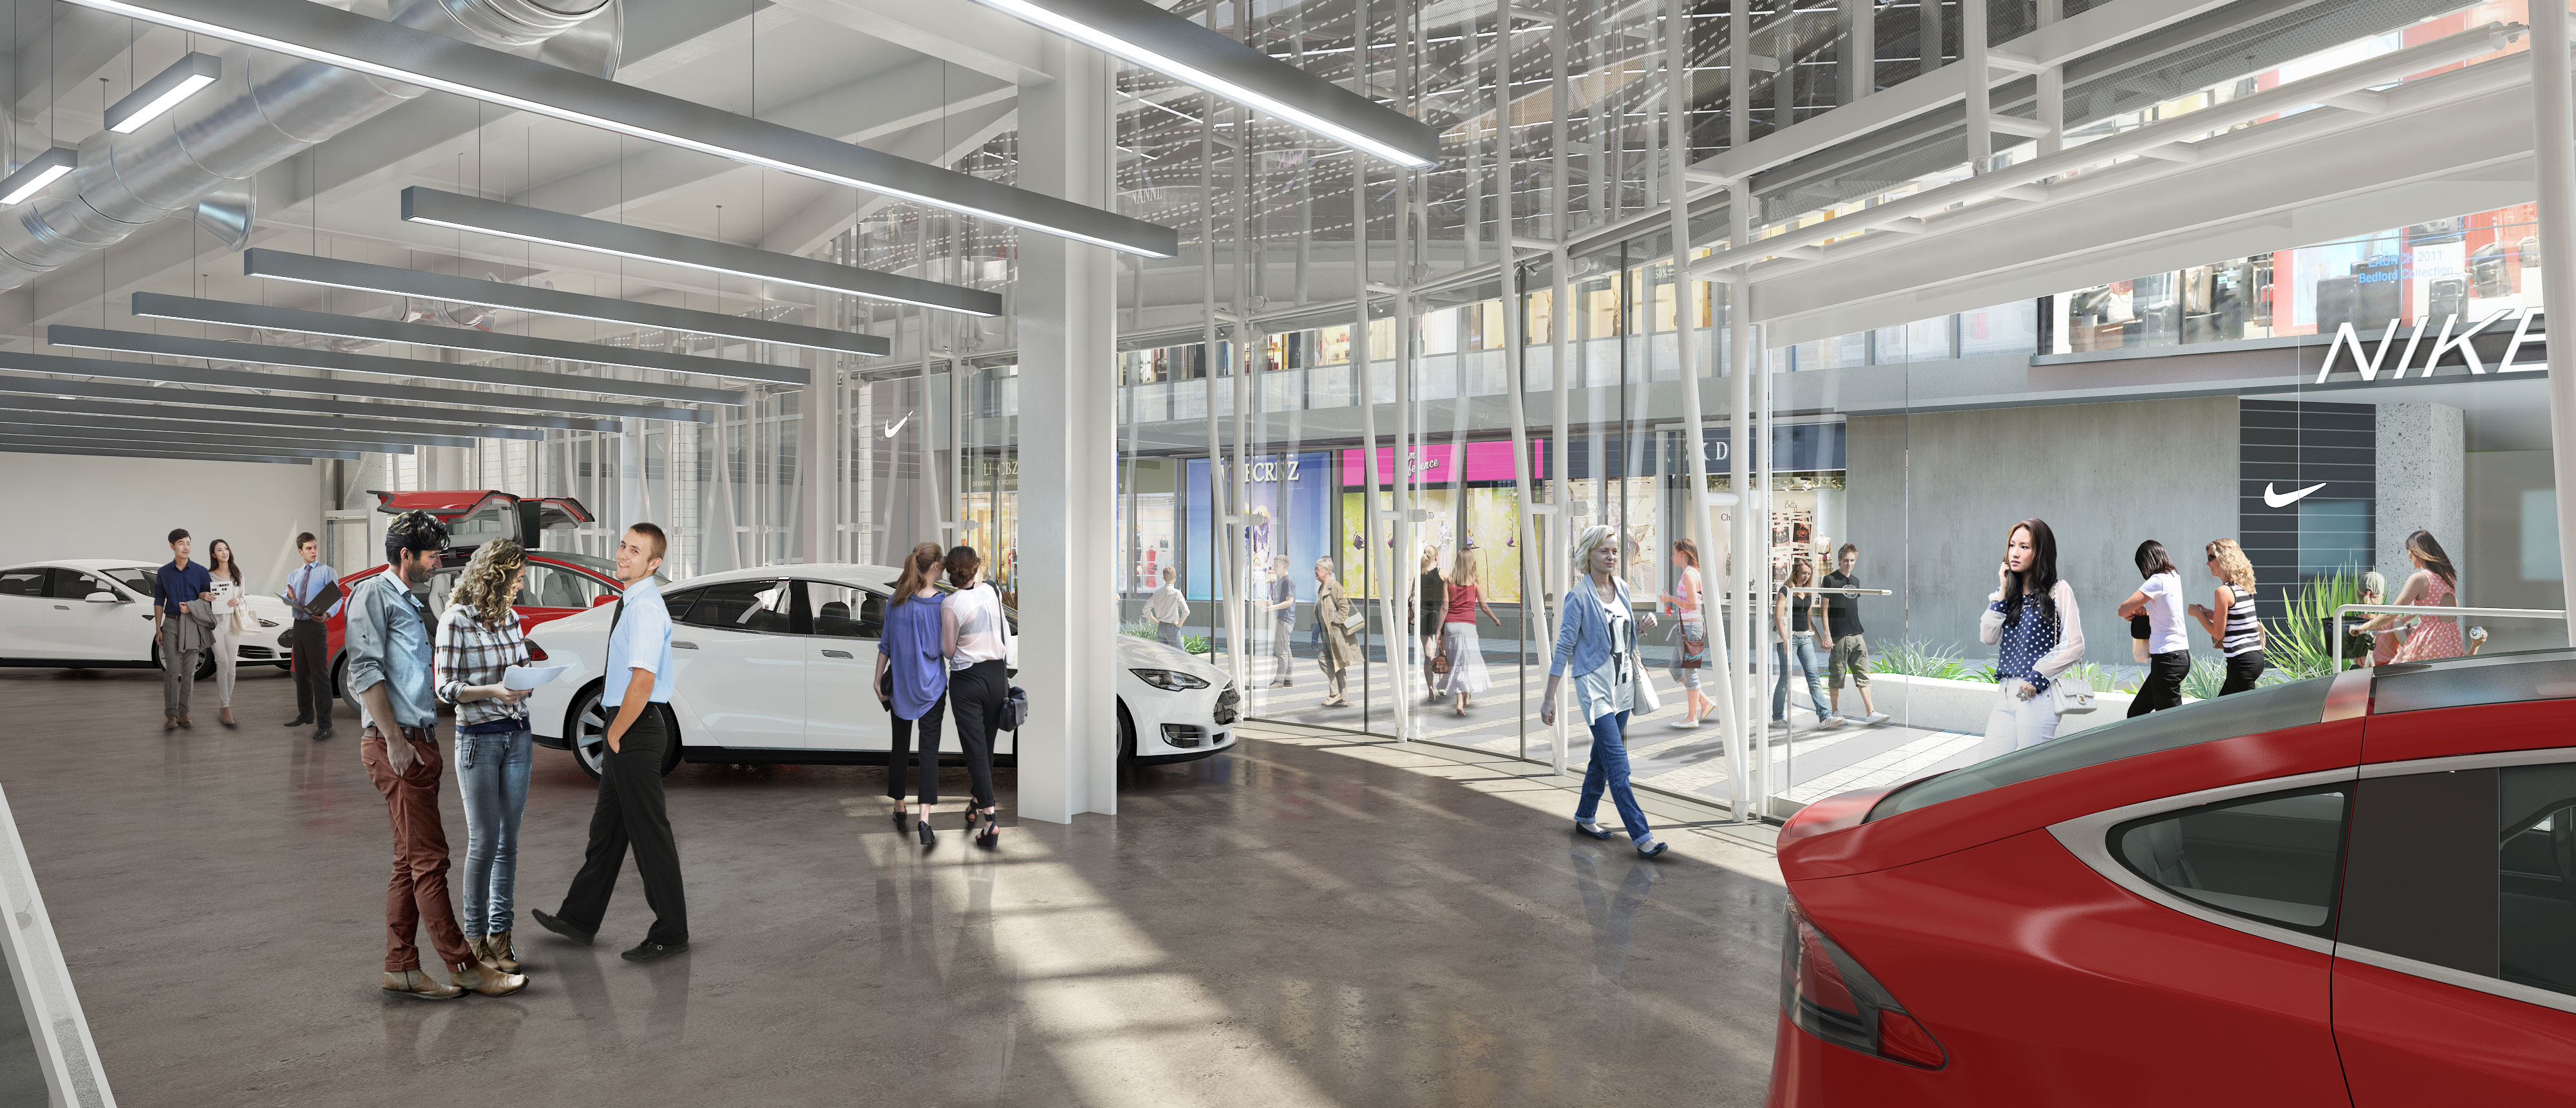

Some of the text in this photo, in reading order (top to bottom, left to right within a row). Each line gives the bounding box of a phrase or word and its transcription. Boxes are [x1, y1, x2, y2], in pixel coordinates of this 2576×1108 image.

[2368, 249, 2442, 268] LAUNCH 2011
[2359, 265, 2454, 283] Bedford Collection
[2315, 306, 2548, 385] NIKE
[1407, 459, 1439, 477] feence
